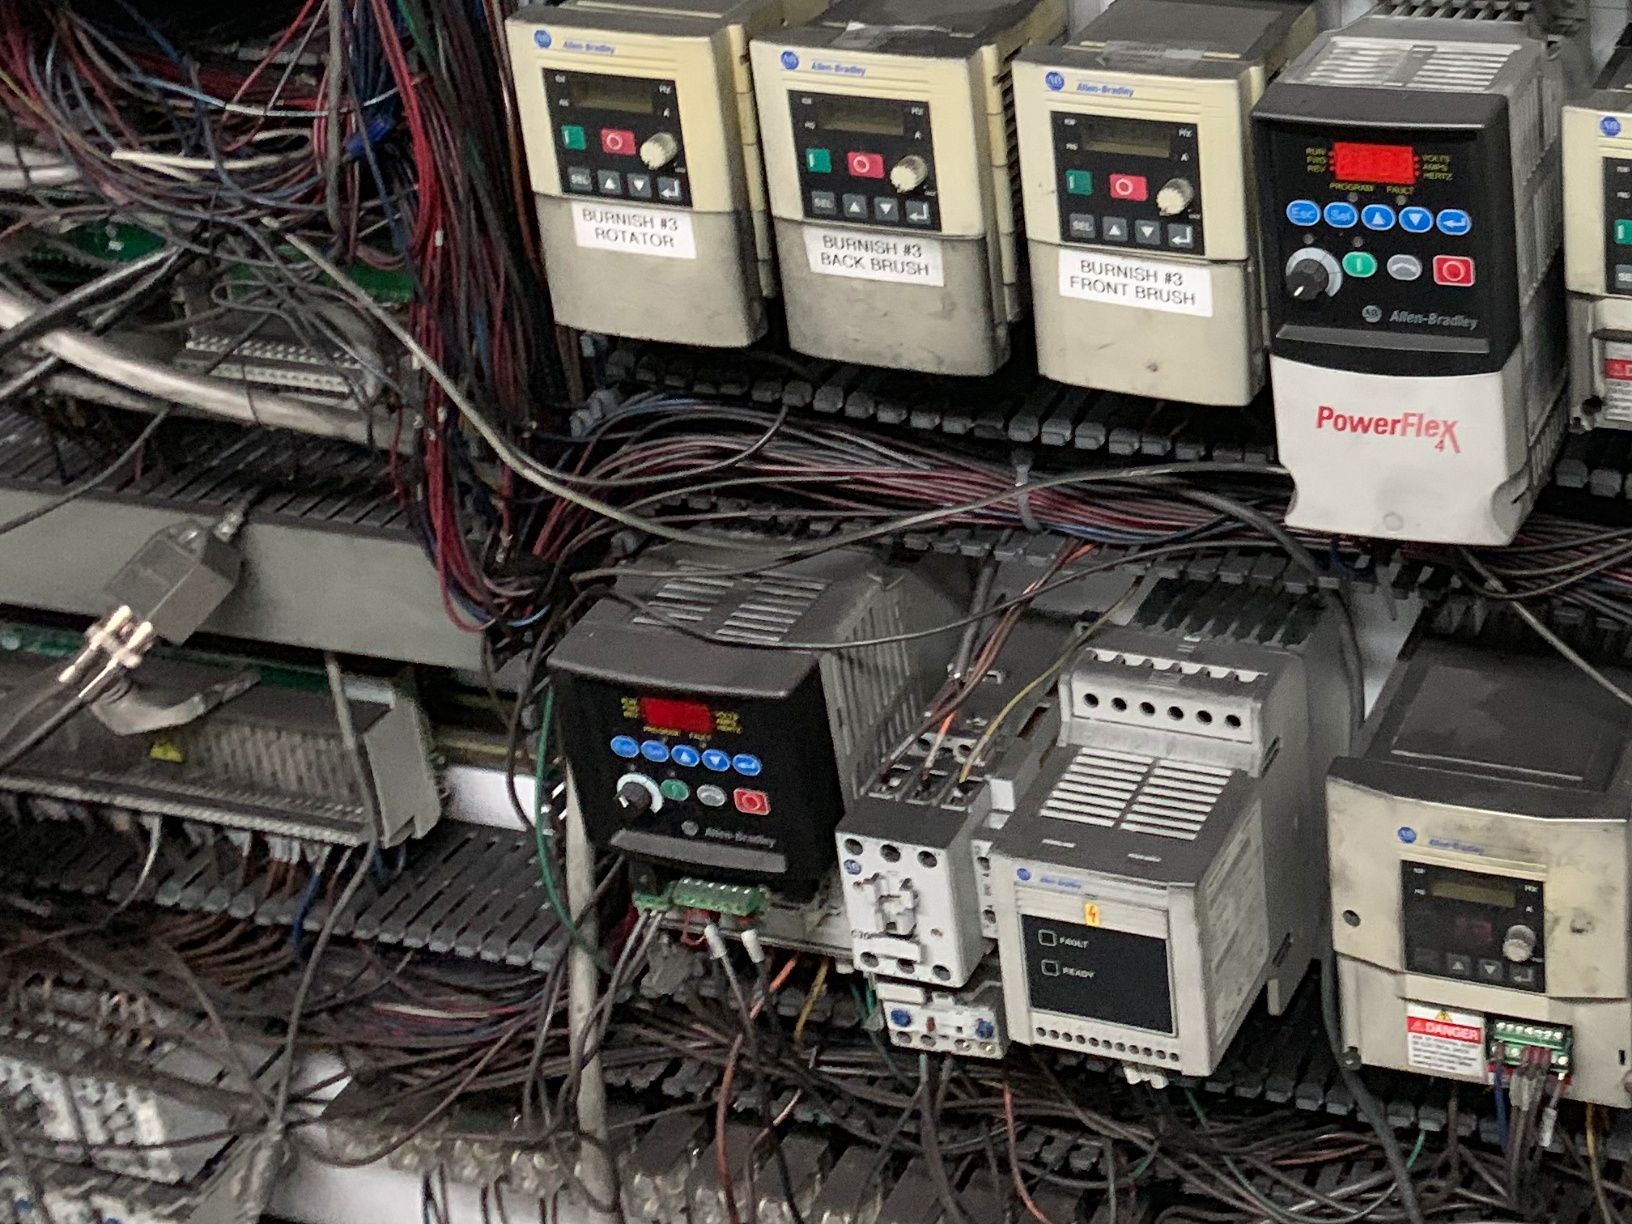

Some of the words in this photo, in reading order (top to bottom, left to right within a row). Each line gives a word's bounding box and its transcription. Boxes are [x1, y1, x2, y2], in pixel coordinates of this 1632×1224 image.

[1076, 82, 1135, 98] Allen-Bradley
[1329, 182, 1375, 193] PROGRAM
[582, 208, 654, 228] BURNISH
[660, 218, 678, 232] #3
[1290, 207, 1315, 220] Esc
[1330, 209, 1351, 221] Sel
[595, 227, 675, 248] ROTATOR
[822, 235, 897, 255] BURNISH
[903, 243, 922, 258] #3
[820, 252, 865, 270] BACK
[870, 257, 929, 276] BRUSH
[1080, 259, 1158, 284] BURNISH
[1164, 271, 1184, 287] #3
[1070, 275, 1129, 297] FRONT
[1135, 285, 1196, 306] BRUSH
[1389, 309, 1478, 330] Allen-Bradley
[1316, 405, 1462, 453] PowerFlex
[1434, 439, 1445, 453] 4
[1425, 1022, 1479, 1041] DANGER
